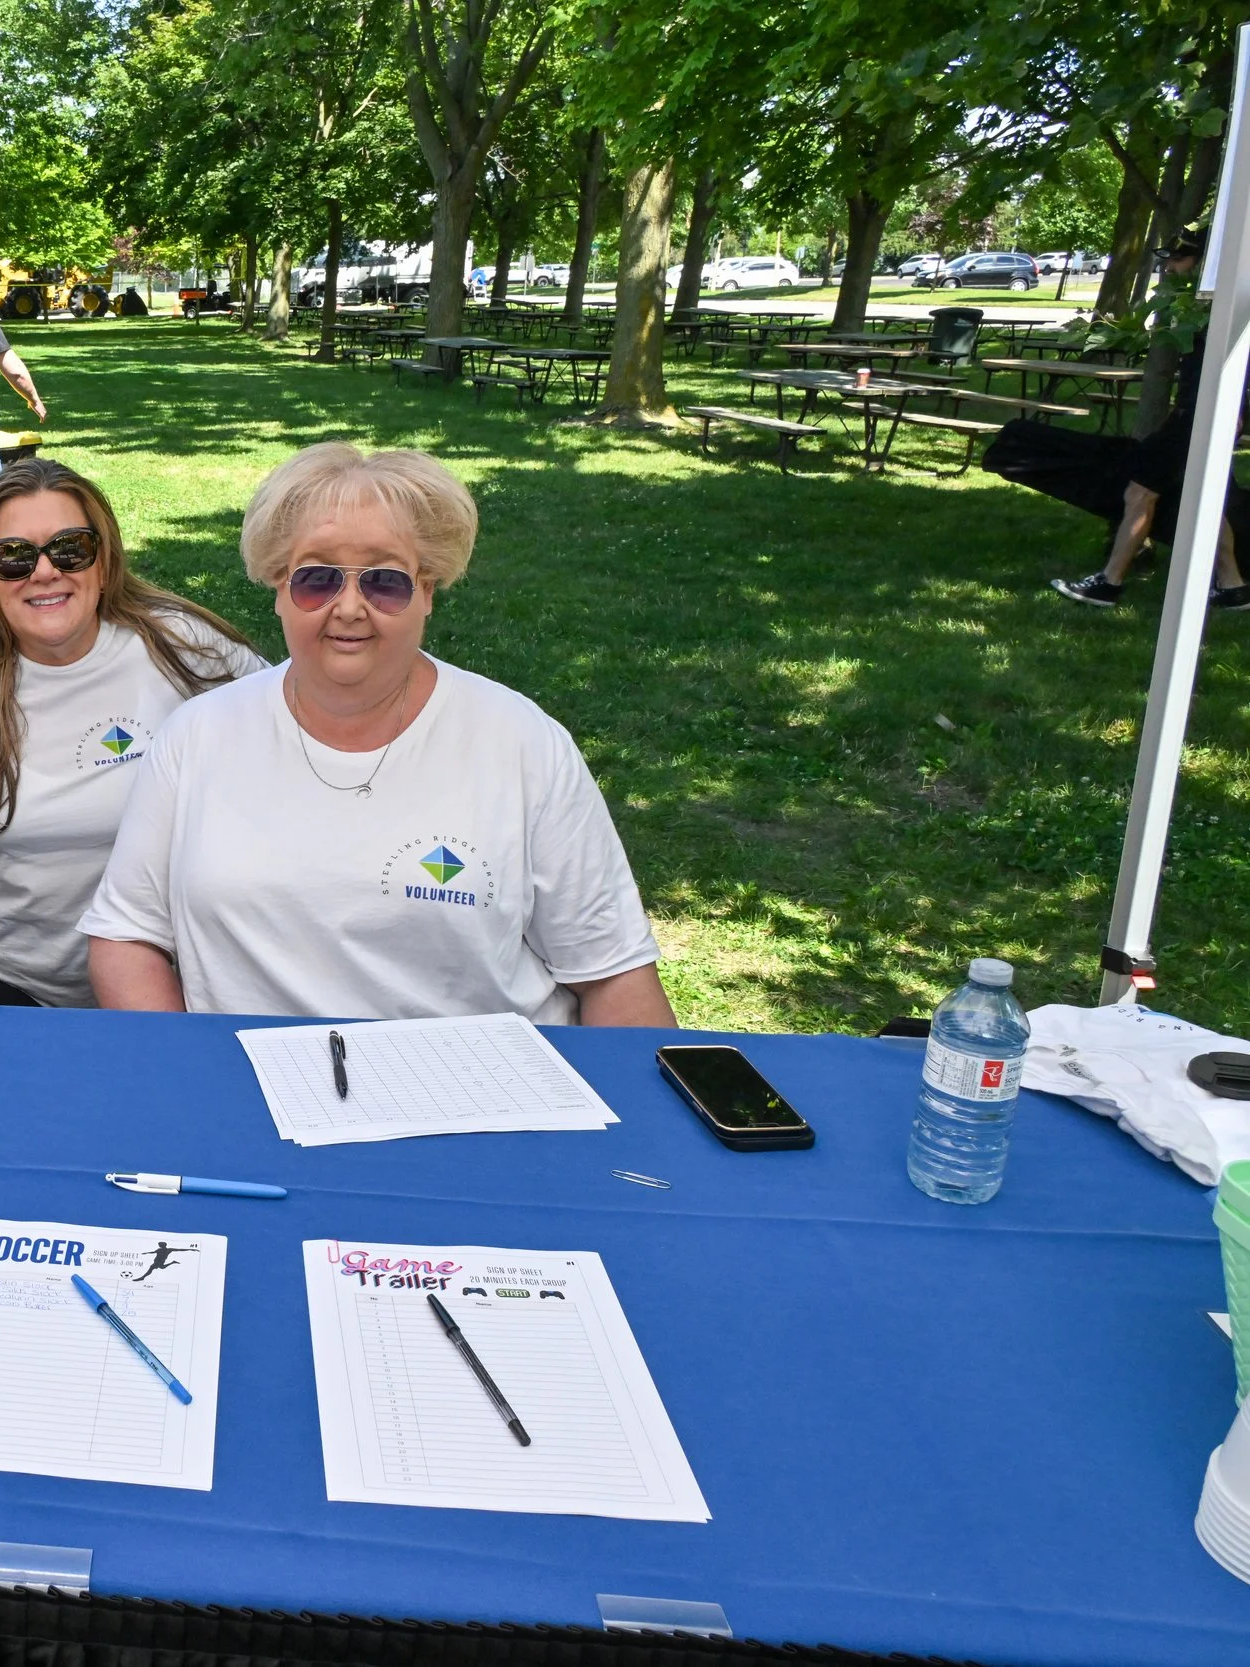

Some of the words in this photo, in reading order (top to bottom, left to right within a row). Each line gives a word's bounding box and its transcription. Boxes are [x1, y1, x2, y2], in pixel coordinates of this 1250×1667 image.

[109, 717, 141, 727] RIDGE
[382, 839, 421, 895] STERLING
[433, 835, 476, 853] RIDGE
[406, 885, 475, 906] VOLUNTEER
[341, 1251, 462, 1276] Game
[486, 1266, 505, 1274] SIGN
[520, 1268, 543, 1276] SHEET
[356, 1270, 452, 1291] Trailer
[482, 1276, 518, 1285] MINUTES
[520, 1278, 539, 1286] EACH
[542, 1279, 567, 1287] GROUP
[498, 1289, 527, 1297] START
